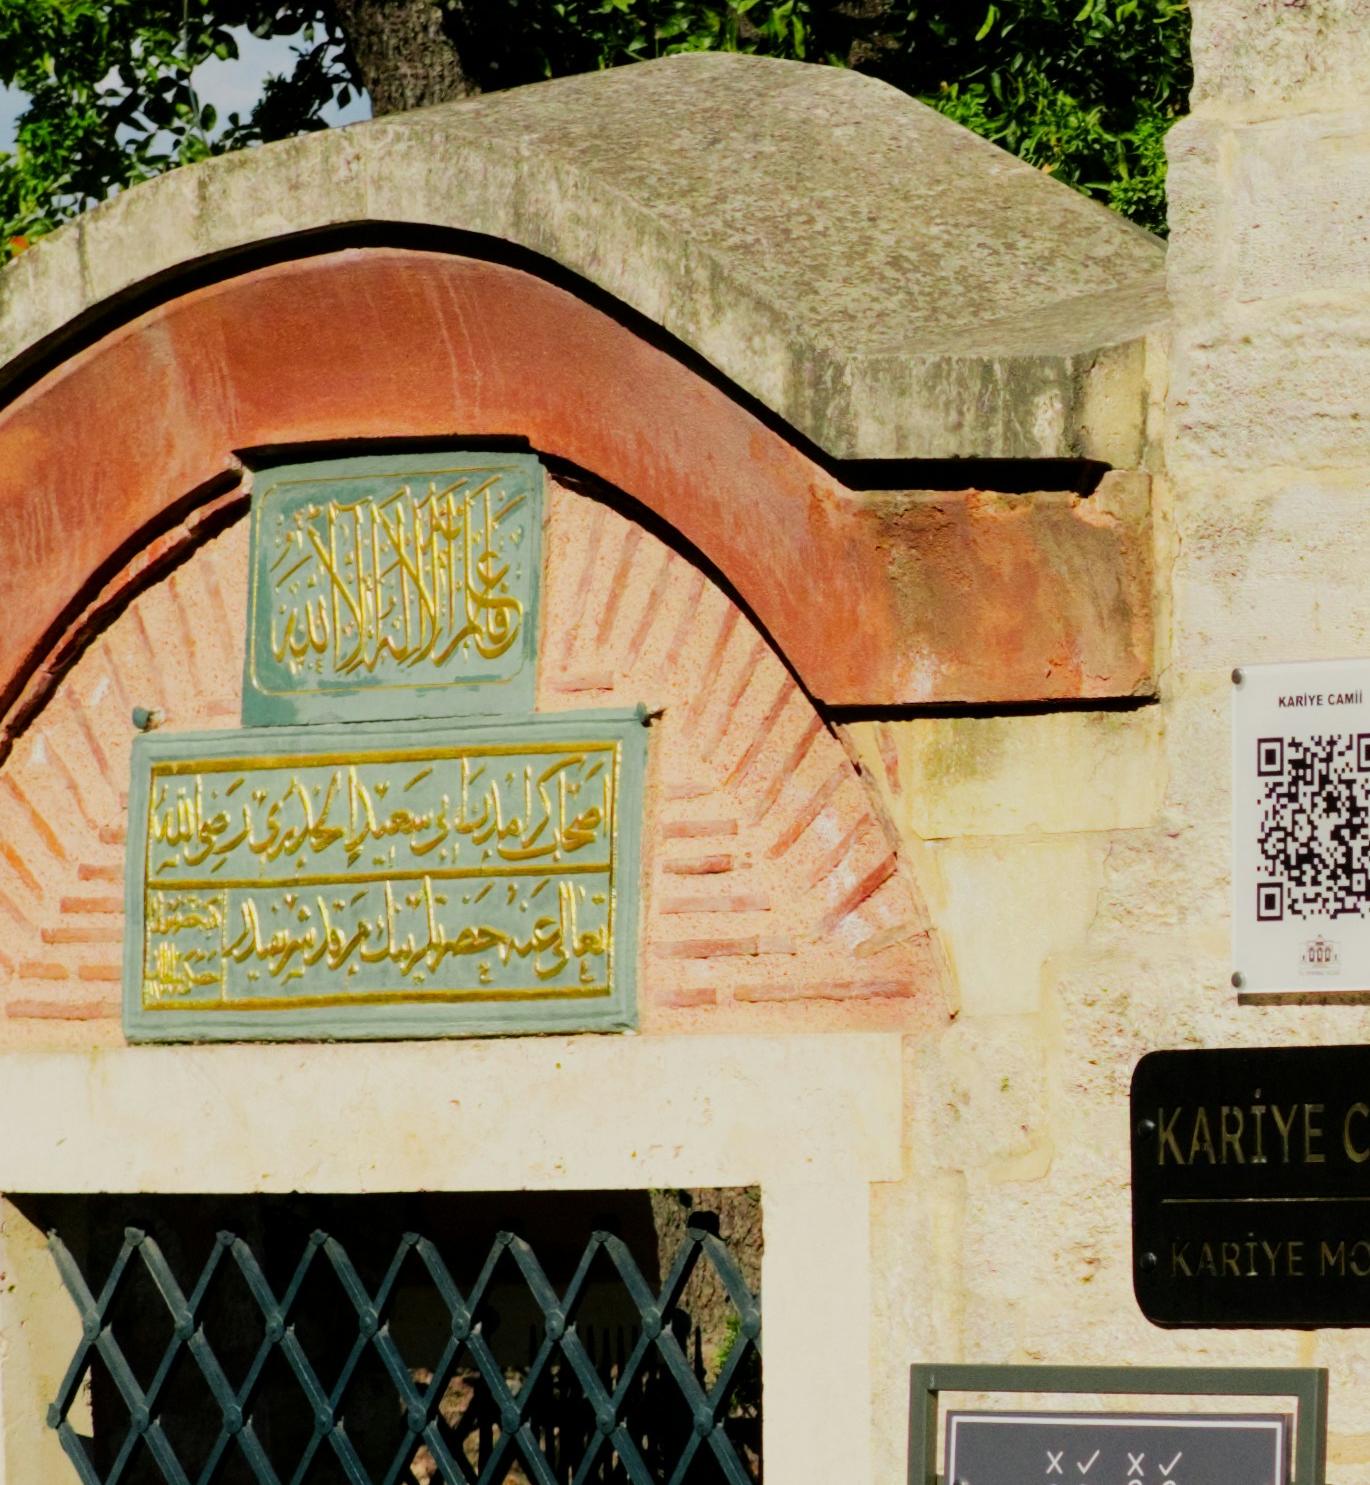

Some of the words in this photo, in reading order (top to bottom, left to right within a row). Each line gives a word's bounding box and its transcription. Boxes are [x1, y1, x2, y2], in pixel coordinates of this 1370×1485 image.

[1278, 693, 1324, 708] KARİYE
[1327, 689, 1363, 706] CAMİİ
[1158, 1088, 1326, 1165] KARİYE
[1171, 1232, 1304, 1277] KARİYE
